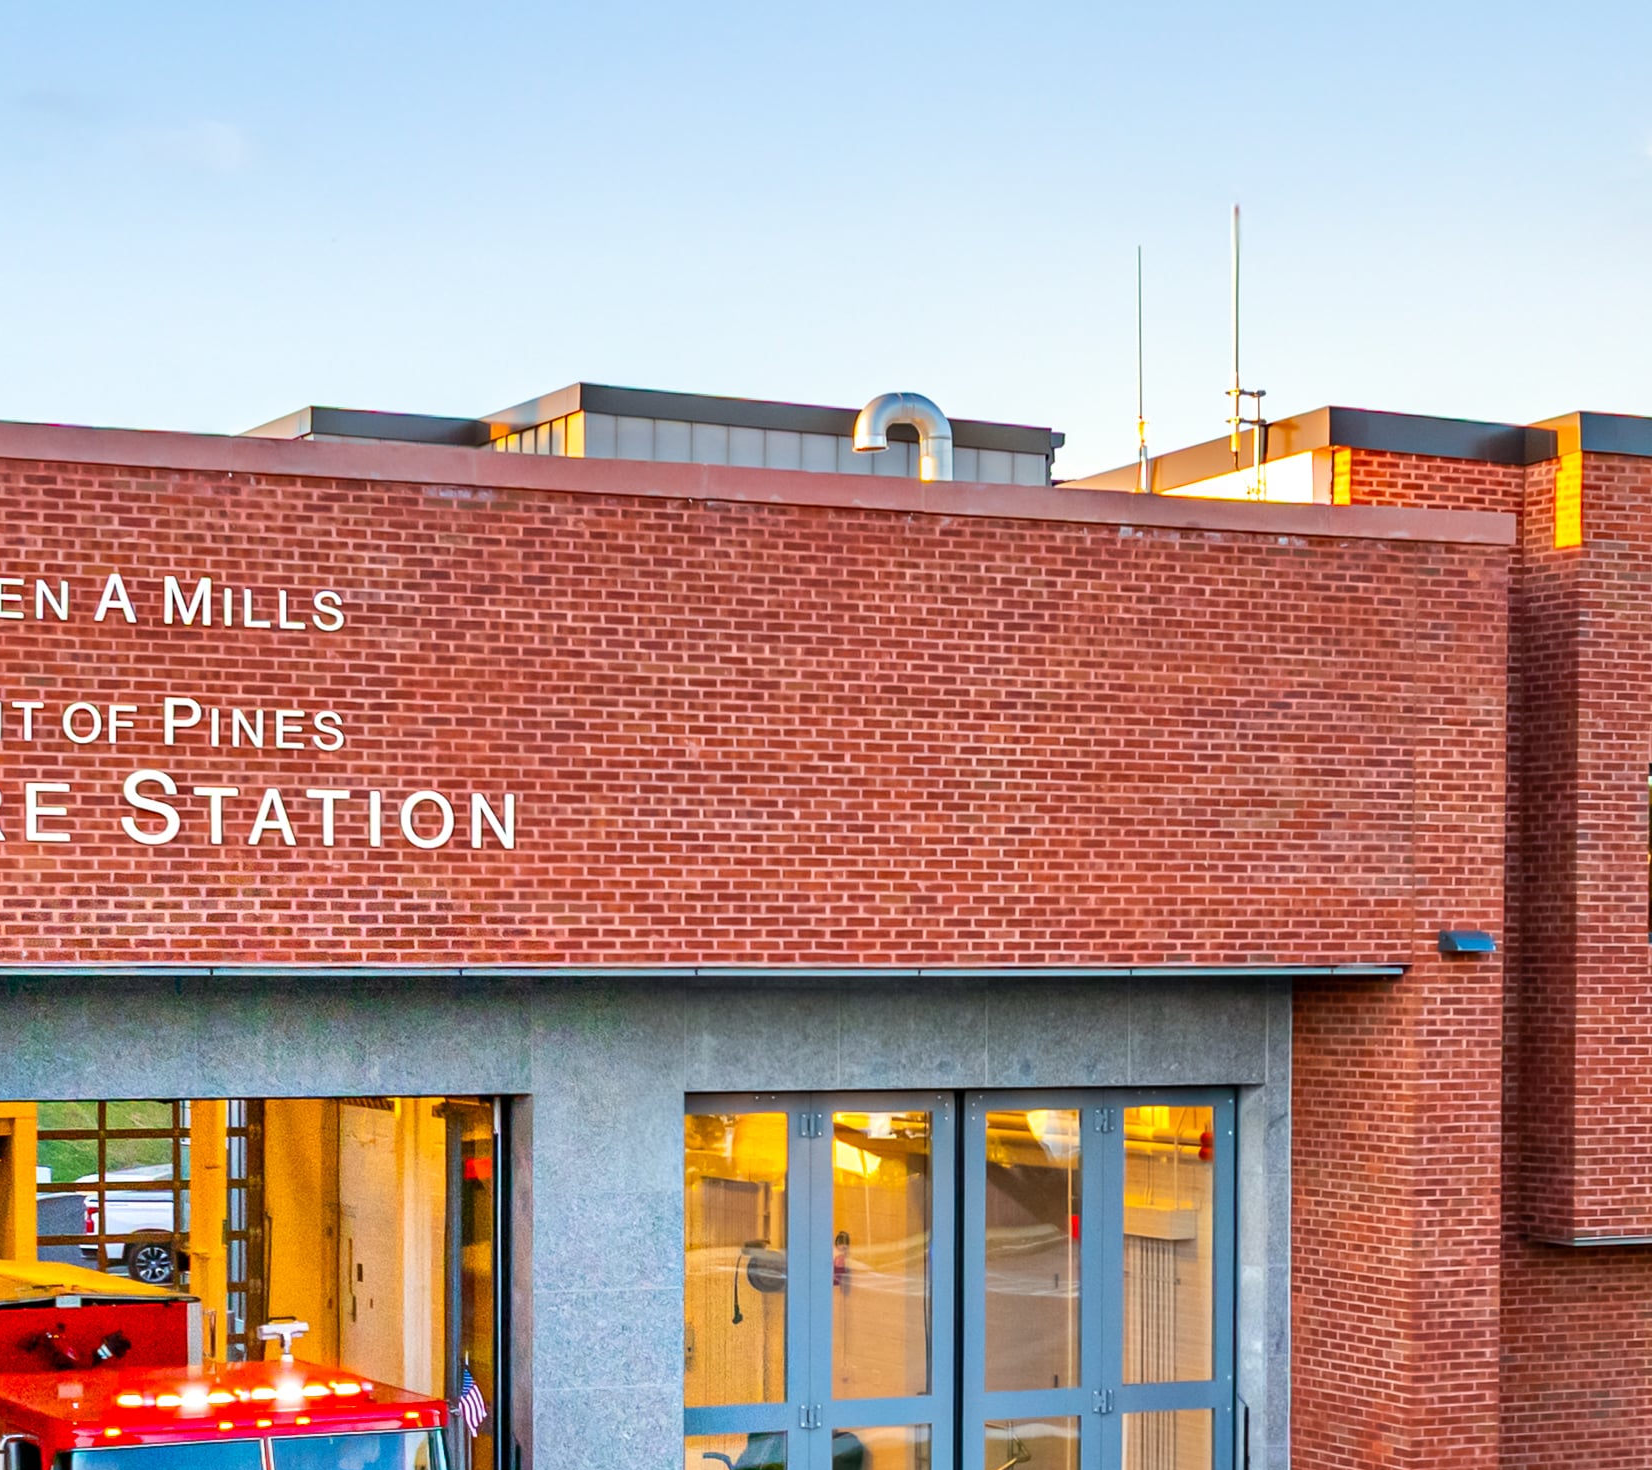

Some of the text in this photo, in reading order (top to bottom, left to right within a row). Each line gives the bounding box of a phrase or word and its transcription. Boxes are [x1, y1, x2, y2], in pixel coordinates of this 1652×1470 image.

[94, 573, 137, 623] A
[164, 575, 344, 631] MILLS
[62, 701, 138, 744] OF
[164, 697, 344, 752] PINES
[120, 769, 515, 849] STATION
